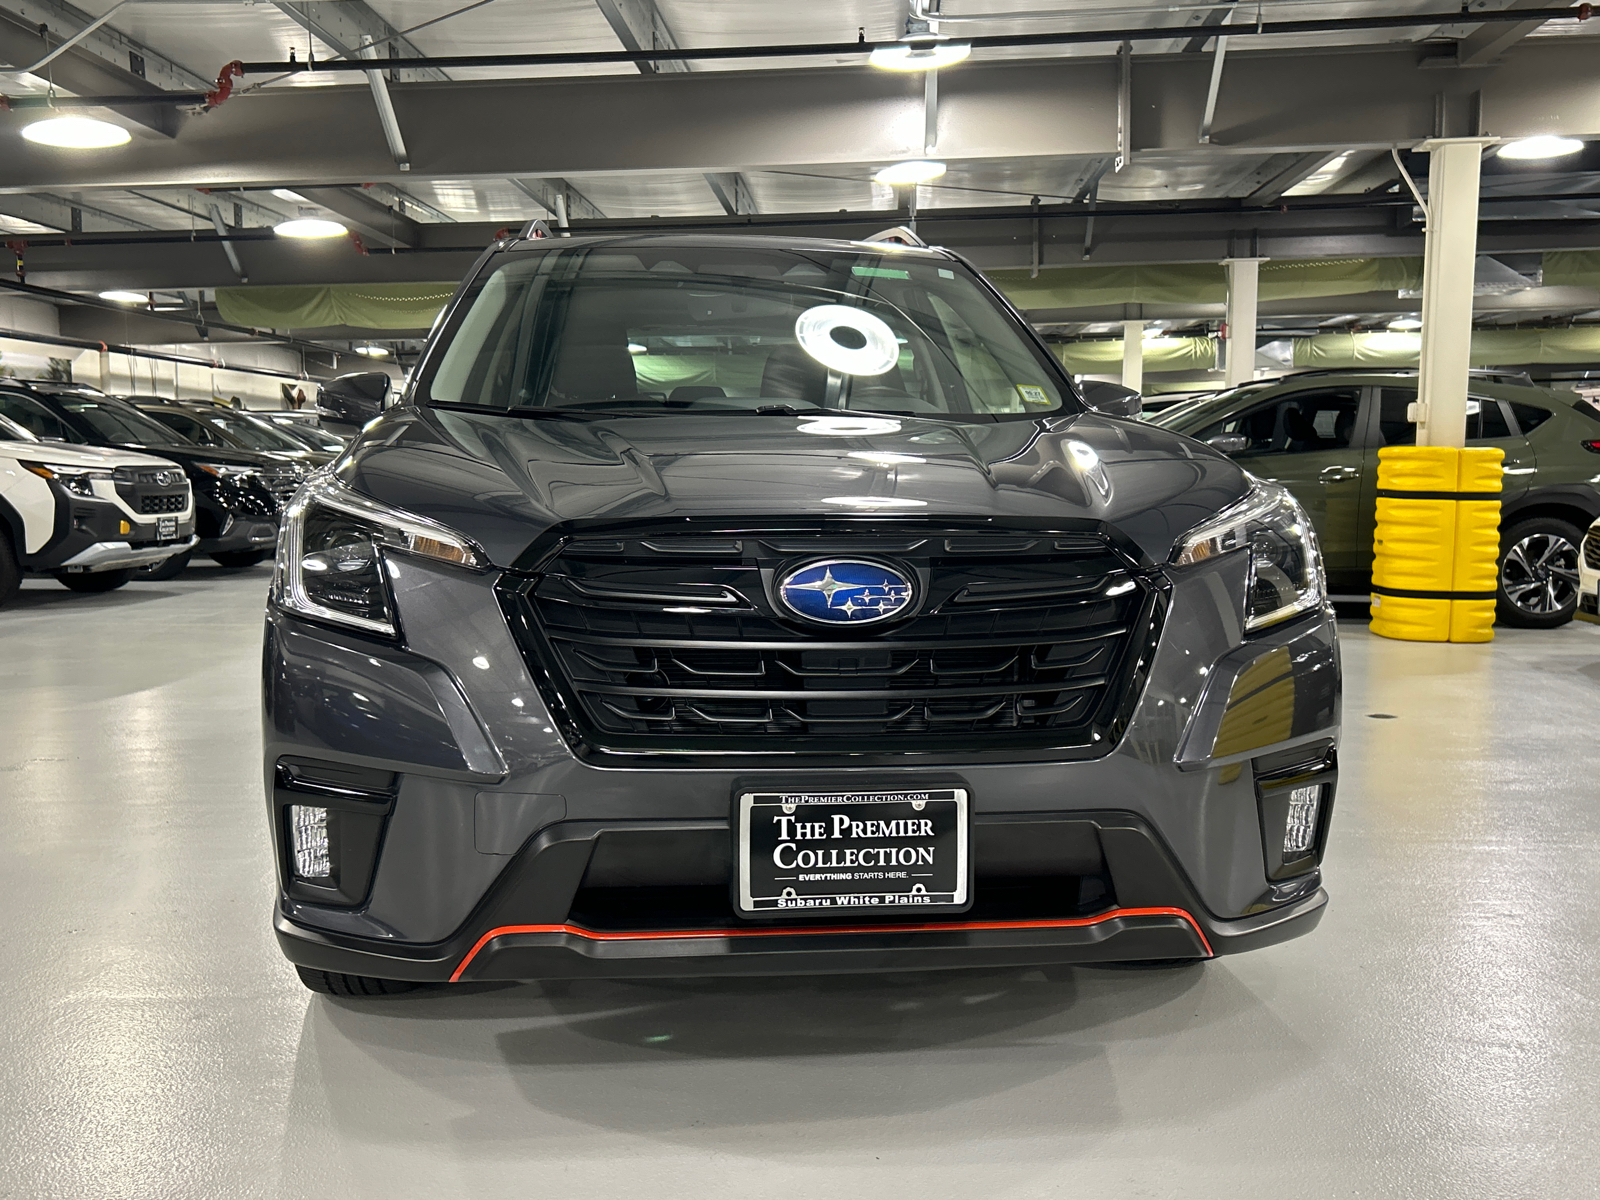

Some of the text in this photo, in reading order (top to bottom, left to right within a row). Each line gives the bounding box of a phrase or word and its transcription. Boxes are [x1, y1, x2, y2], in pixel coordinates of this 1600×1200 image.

[773, 814, 935, 840] THE PREMIER
[773, 842, 935, 869] COLLECTION
[798, 871, 909, 881] EVERYTHING STARTS HERE.
[777, 894, 931, 908] Subaru White Plains
